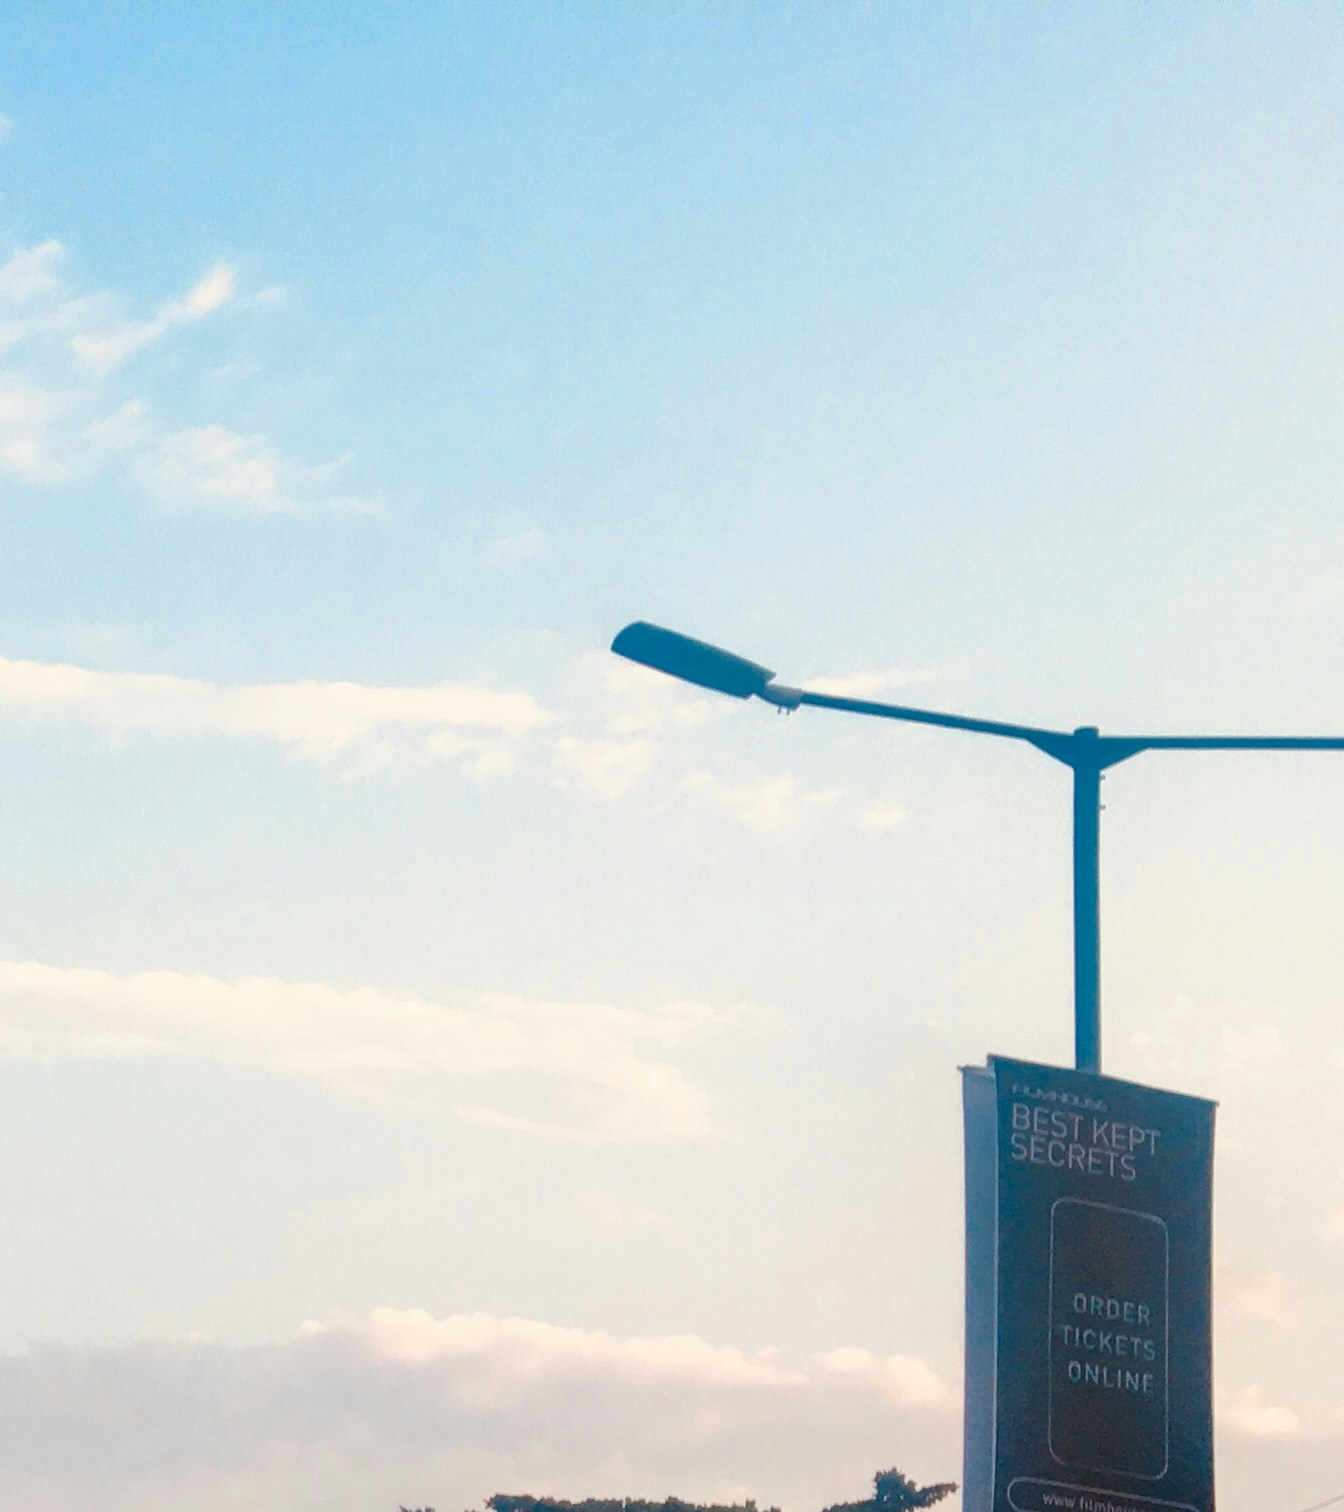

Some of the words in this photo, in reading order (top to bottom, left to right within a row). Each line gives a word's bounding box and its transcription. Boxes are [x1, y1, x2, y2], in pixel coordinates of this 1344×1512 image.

[1013, 1102, 1085, 1142] BEST
[1092, 1117, 1161, 1155] KEPT
[1011, 1132, 1137, 1182] SECRETS
[1073, 1292, 1151, 1326] ORDER
[1061, 1324, 1156, 1362] TICKETS
[1067, 1360, 1154, 1395] ONLINE
